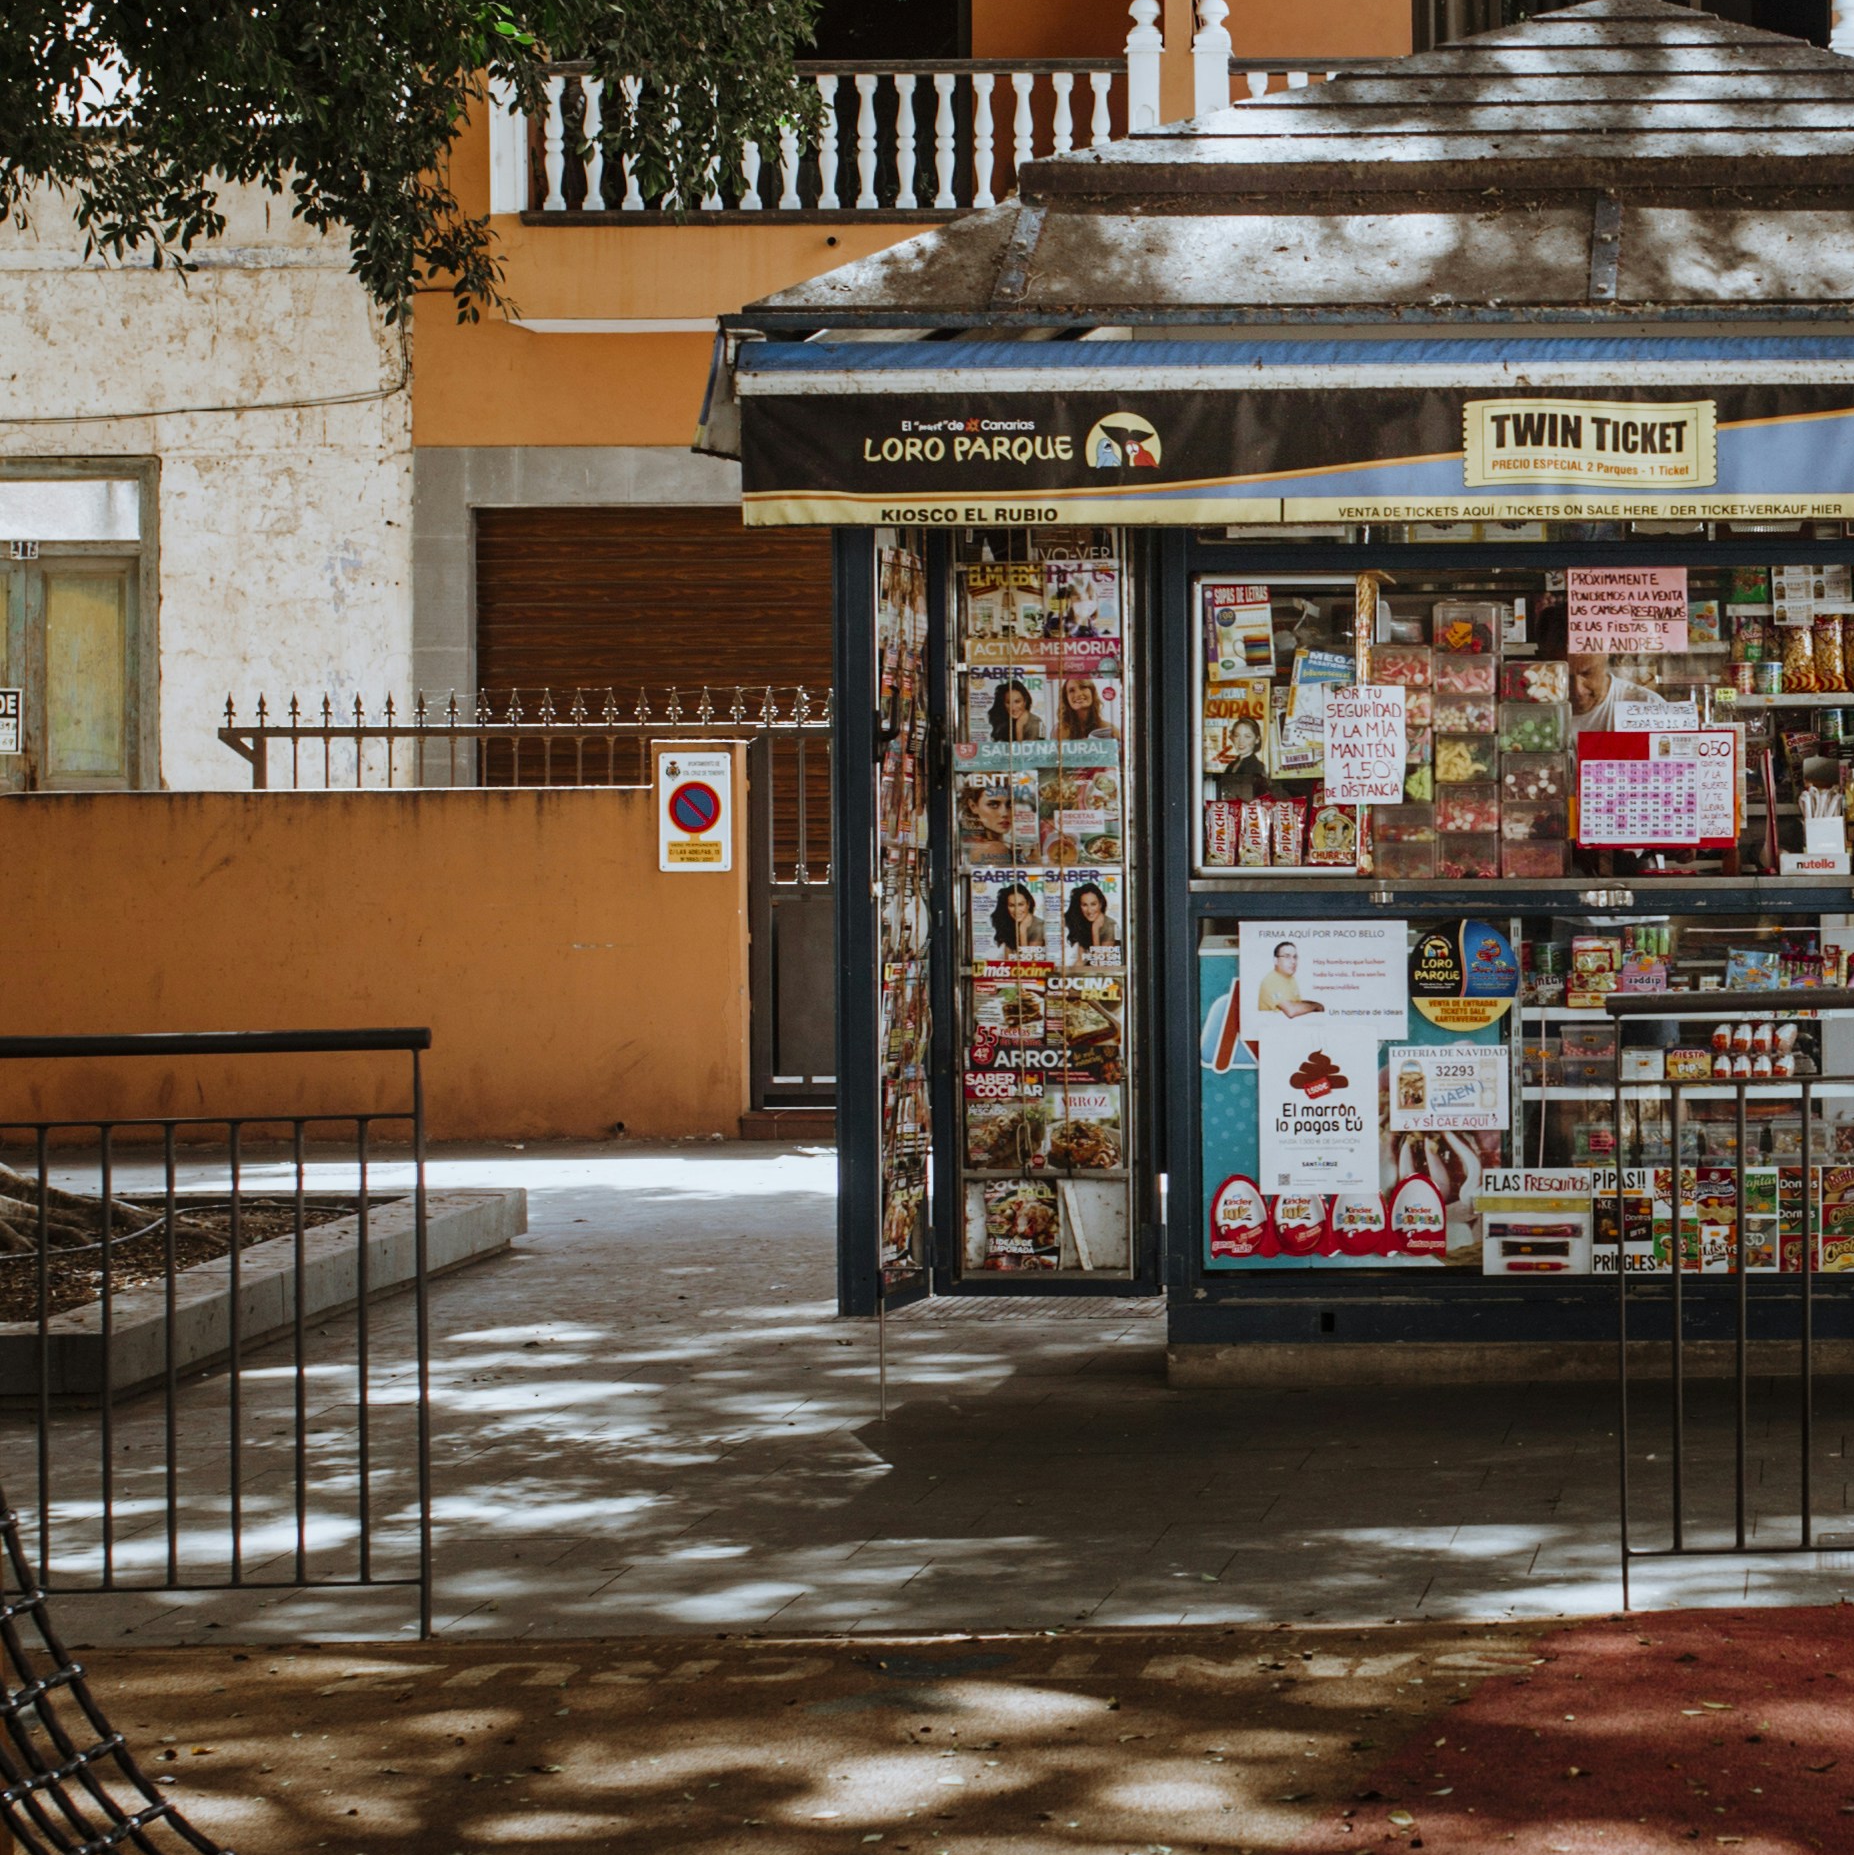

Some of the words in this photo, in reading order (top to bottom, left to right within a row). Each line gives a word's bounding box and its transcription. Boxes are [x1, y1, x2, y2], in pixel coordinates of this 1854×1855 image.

[901, 420, 912, 432] El
[981, 419, 1035, 432] Canarias
[1491, 412, 1582, 450] TWIN
[1592, 416, 1687, 454] TICKET
[864, 438, 945, 463] LORO
[953, 435, 1073, 464] PARQUE
[1492, 458, 1531, 472] PRECIO
[1534, 459, 1584, 472] ESPECIAL
[1587, 461, 1594, 473] 2
[1597, 461, 1638, 477] Parques
[1650, 465, 1655, 476] 1
[1658, 464, 1690, 477] Ticket
[881, 508, 957, 522] KIOSCO
[965, 509, 988, 522] EL
[994, 508, 1058, 522] RUBIO
[1338, 506, 1379, 518] VENTA
[1384, 506, 1401, 518] DE
[1404, 505, 1460, 518] TICKETS
[1506, 505, 1560, 517] TICKETS
[1564, 504, 1584, 517] ON
[1587, 504, 1620, 517] SALE
[1623, 504, 1658, 516] HERE
[1671, 504, 1697, 516] DER
[1701, 503, 1807, 516] TICKET-VERKAUF
[1811, 502, 1842, 516] HIER
[1214, 587, 1235, 604] SOPAS
[1236, 587, 1245, 603] DE
[1246, 586, 1268, 603] LETRAS
[1571, 591, 1626, 601] PONDREMOS
[1628, 591, 1635, 601] A
[1638, 591, 1650, 601] LA
[1652, 590, 1684, 601] VENTA
[1571, 606, 1588, 616] LAS
[1591, 604, 1630, 616] CAMISAS
[1570, 622, 1582, 631] DE
[1585, 622, 1602, 631] LAS
[1607, 620, 1648, 633] FIESTAS
[1654, 622, 1669, 633] DE
[1575, 636, 1603, 652] SAN
[970, 667, 1025, 680] SABER
[1334, 689, 1359, 700] POR
[1365, 689, 1382, 700] TU
[1206, 701, 1264, 719] SOPAS
[1326, 701, 1402, 718] SEGURIDAD
[1330, 723, 1338, 738] Y
[1342, 724, 1362, 738] LA
[982, 744, 1035, 758] SALUD
[1036, 741, 1107, 755] NATURAL
[1325, 787, 1337, 798] DE
[1341, 782, 1400, 798] DISTANCIA
[1215, 804, 1226, 852] PIPACHIC
[1796, 859, 1835, 869] nutella
[973, 870, 1027, 883] SABER
[1045, 869, 1100, 883] SABER
[1258, 930, 1285, 938] FIRMA
[1313, 930, 1331, 938] POR
[1333, 930, 1356, 938] PACO
[1358, 930, 1385, 938] BELLO
[1422, 959, 1453, 969] LORO
[1414, 970, 1460, 982] PARQUE
[1329, 1008, 1339, 1016] Un
[1341, 1008, 1371, 1016] hombre
[1372, 1008, 1382, 1016] de
[1383, 1008, 1403, 1016] ideas
[976, 1025, 998, 1046] 55
[993, 1049, 1072, 1068] ARROZ
[1440, 1049, 1455, 1057] DE
[1456, 1048, 1508, 1057] NAVIDAD
[1673, 1049, 1706, 1059] FIESTA
[1435, 1065, 1475, 1077] 32293
[965, 1073, 1015, 1086] SABER
[975, 1085, 1043, 1097] COCINAR
[1283, 1103, 1297, 1117] El
[1301, 1103, 1356, 1117] marrón
[1276, 1118, 1289, 1132] lo
[1294, 1120, 1340, 1135] pagas
[1345, 1116, 1363, 1131] tú
[1437, 1118, 1458, 1127] CAE
[1485, 1174, 1521, 1192] FLAS
[1524, 1173, 1590, 1192] FRESQUITOS
[1224, 1199, 1252, 1207] Kinder
[1283, 1198, 1311, 1206] Kinder
[1346, 1206, 1373, 1214] Kinder
[1405, 1206, 1432, 1214] Kinder
